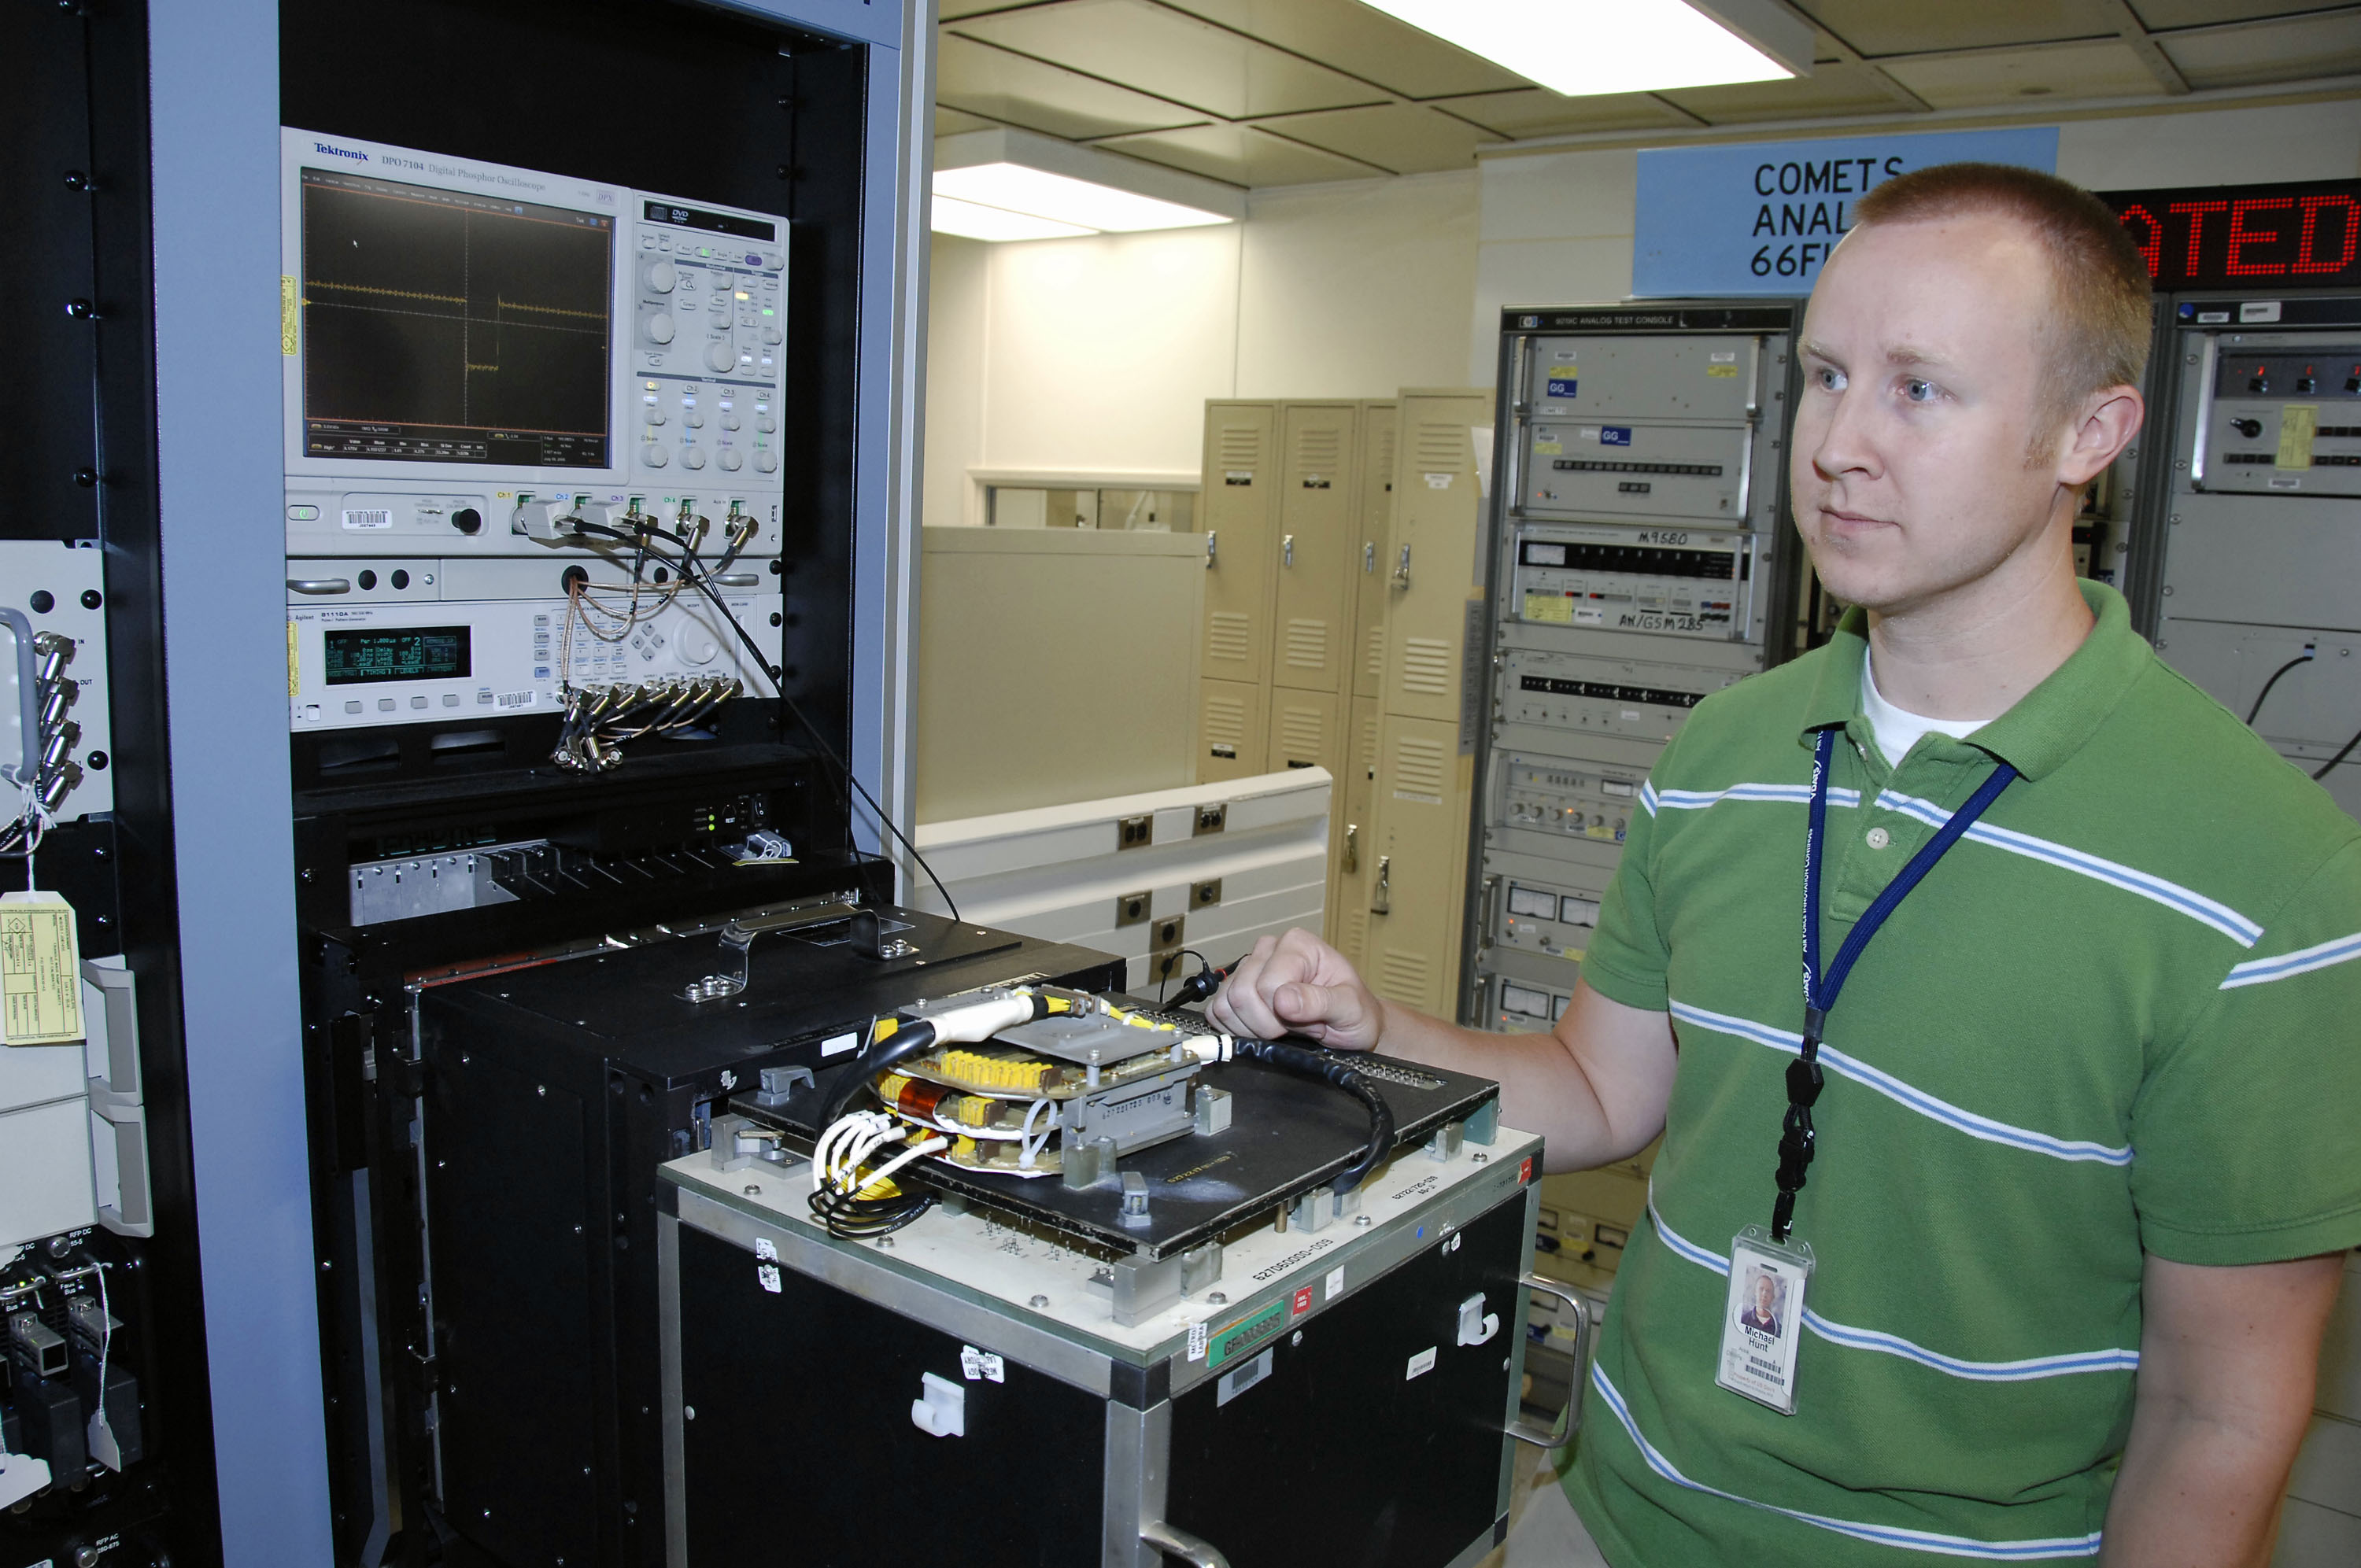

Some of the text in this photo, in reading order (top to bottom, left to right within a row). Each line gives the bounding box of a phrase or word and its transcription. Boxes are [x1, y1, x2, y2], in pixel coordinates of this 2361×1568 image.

[314, 142, 369, 161] Tektronix
[382, 155, 546, 193] DPO 7104 Digital Phosphor Oscilloscope
[597, 192, 614, 203] DPX
[672, 208, 689, 218] DVD
[1580, 316, 1613, 325] ANALOG
[1615, 316, 1633, 325] TEST
[1635, 315, 1674, 324] CONSOLE
[1550, 382, 1565, 393] GG
[1602, 430, 1619, 441] GG
[1638, 532, 1688, 545] M9580
[414, 636, 421, 646] 2
[25, 1242, 35, 1251] DC
[1252, 1238, 1334, 1281] 627060000-009
[1744, 1326, 1775, 1345] Michael
[1749, 1337, 1768, 1352] Hunt
[95, 1537, 109, 1546] RFP
